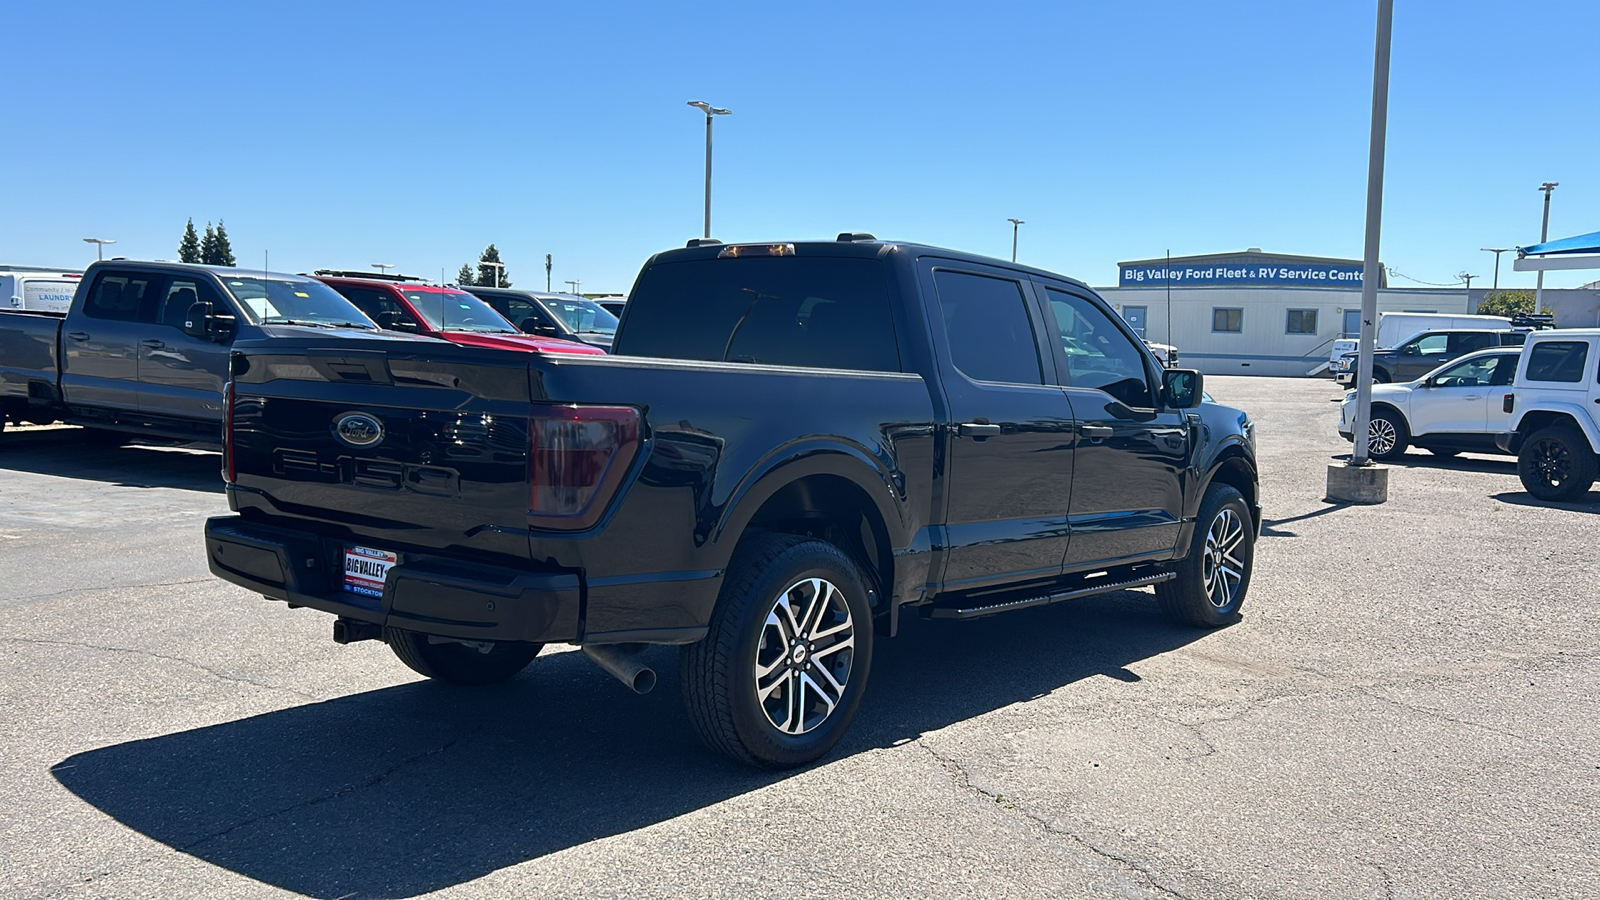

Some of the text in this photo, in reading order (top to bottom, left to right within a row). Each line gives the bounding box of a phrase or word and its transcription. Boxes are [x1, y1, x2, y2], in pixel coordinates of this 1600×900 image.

[1124, 267, 1364, 281] Big Valley Ford Fleet & RV Service Cente
[272, 447, 462, 498] F-150
